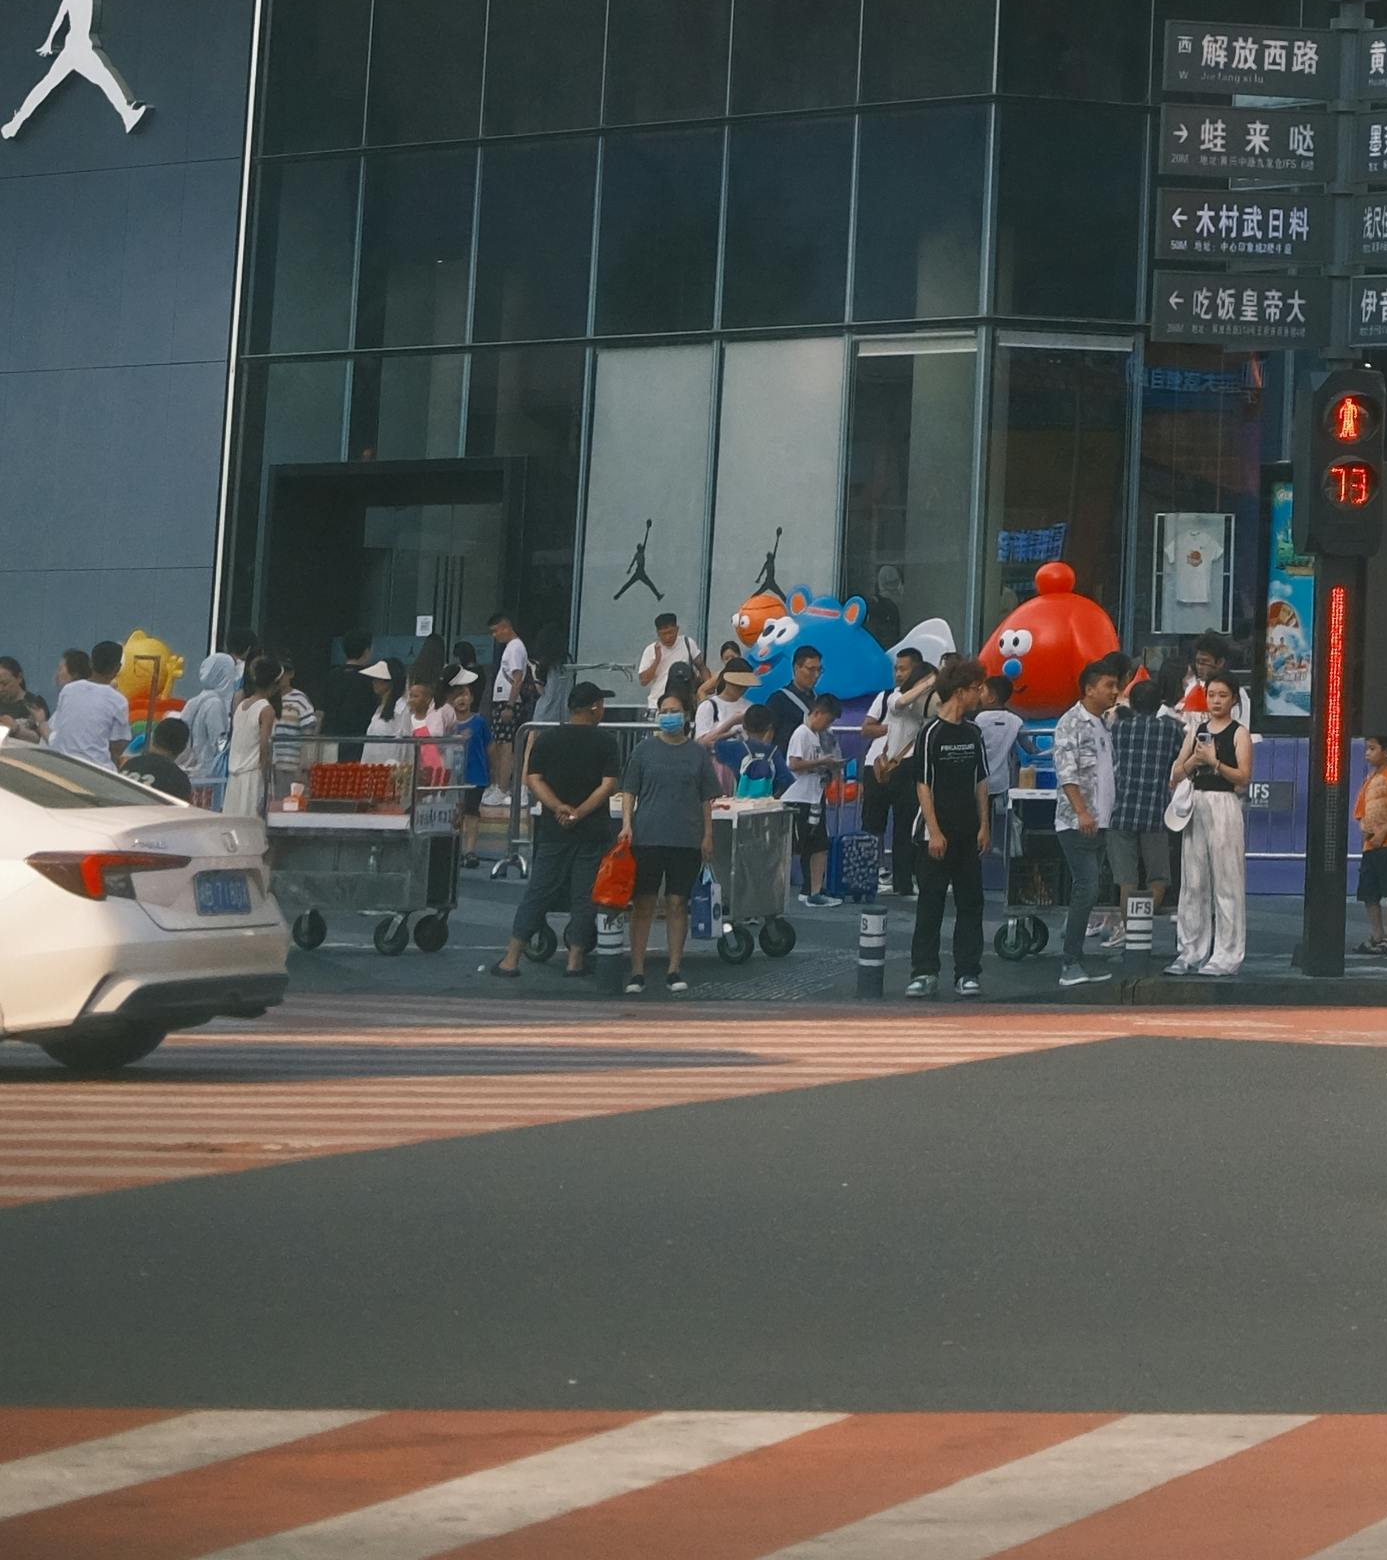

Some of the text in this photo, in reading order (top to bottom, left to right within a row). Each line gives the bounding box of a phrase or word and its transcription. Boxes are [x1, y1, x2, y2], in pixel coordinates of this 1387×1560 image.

[1177, 33, 1319, 75] 西 解放西路
[1178, 70, 1189, 80] W
[1195, 202, 1310, 241] 木村武日料
[1192, 286, 1307, 323] 吃饭皇帝大
[1249, 783, 1270, 799] IFS
[1131, 901, 1152, 915] IFS
